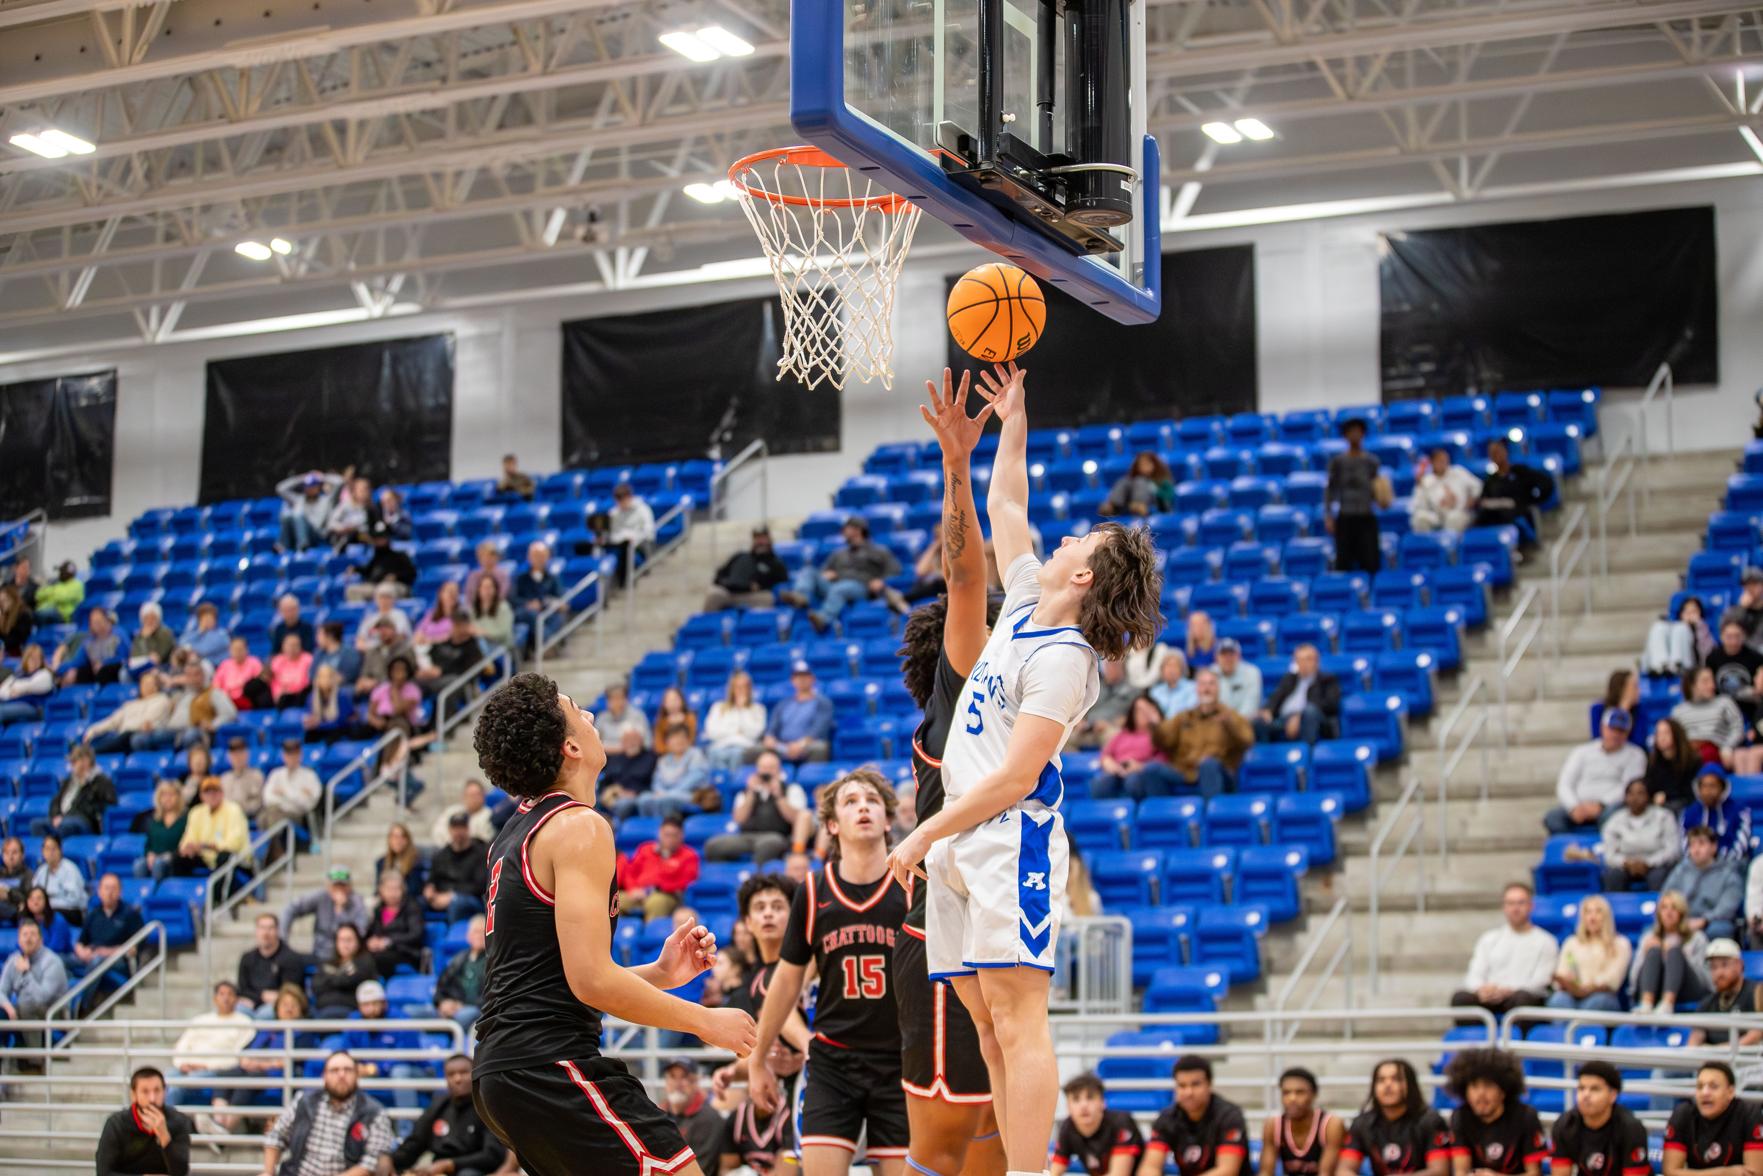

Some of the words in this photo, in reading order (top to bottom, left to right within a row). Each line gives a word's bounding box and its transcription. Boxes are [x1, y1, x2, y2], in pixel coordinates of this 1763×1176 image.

[966, 691, 985, 736] 5
[822, 923, 899, 955] CHATTOOG
[842, 953, 887, 1000] 15
